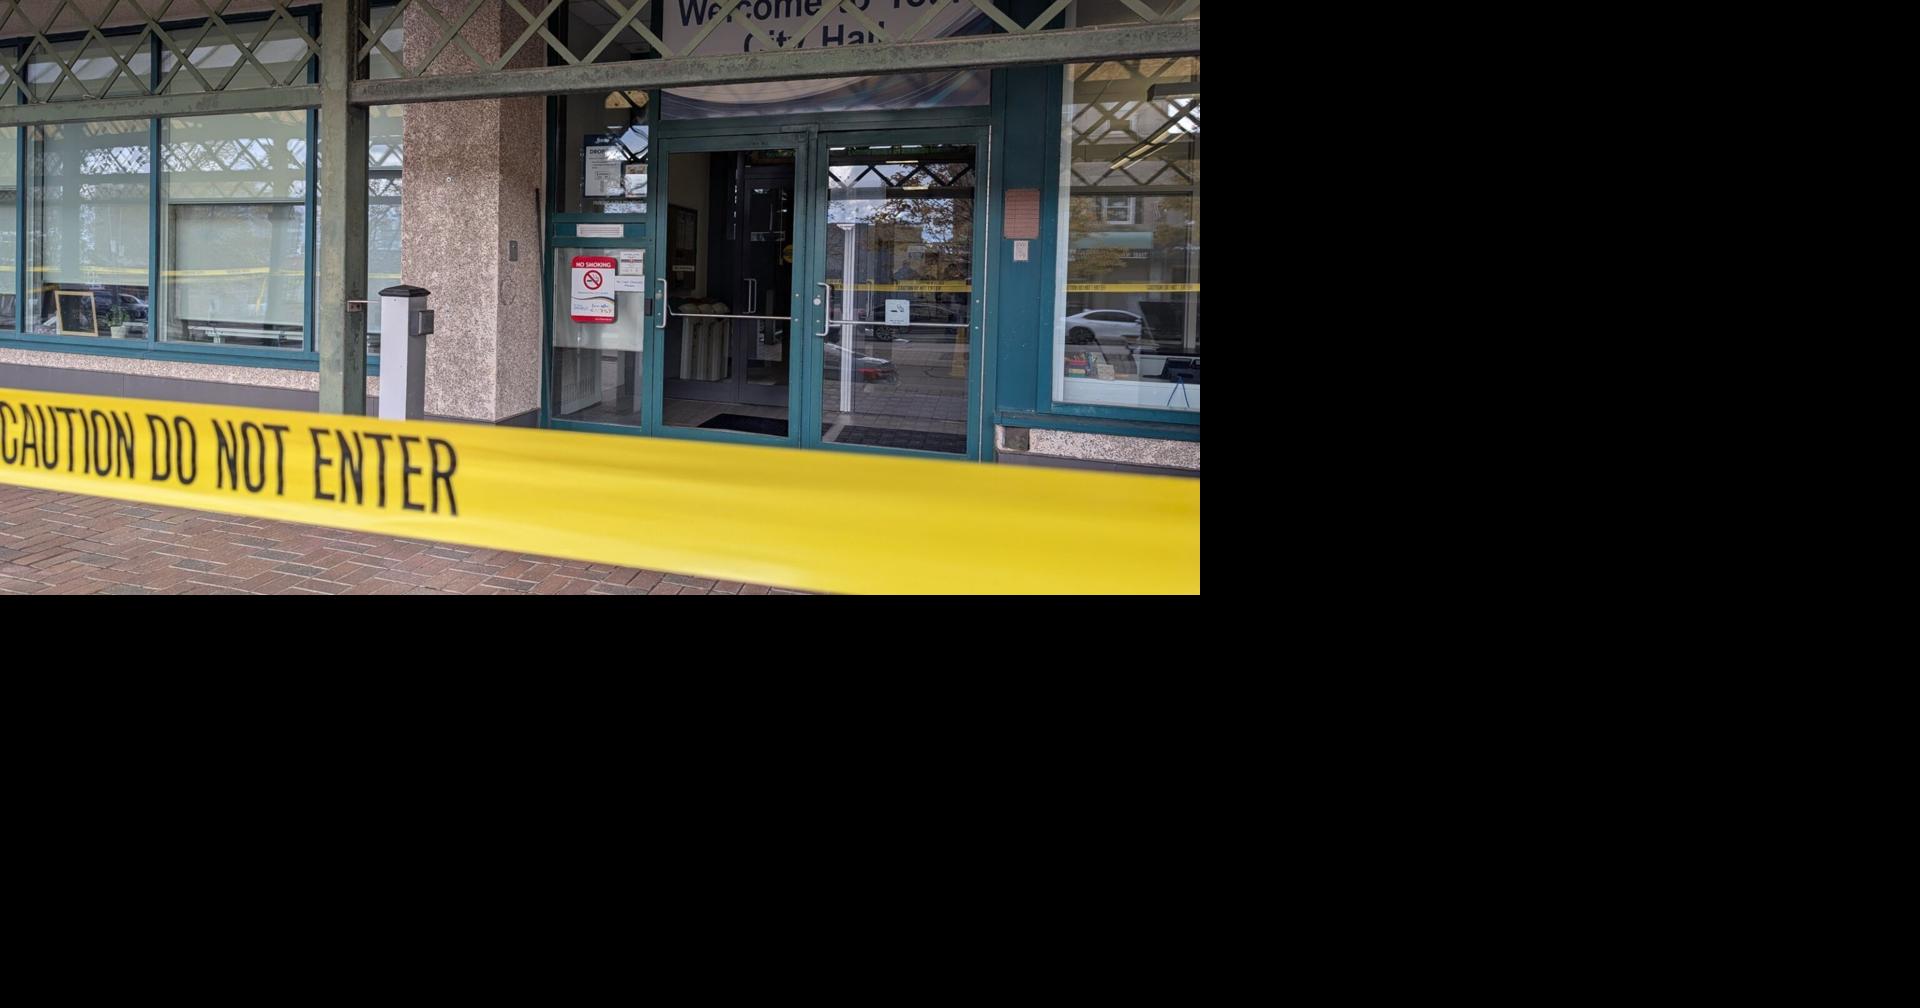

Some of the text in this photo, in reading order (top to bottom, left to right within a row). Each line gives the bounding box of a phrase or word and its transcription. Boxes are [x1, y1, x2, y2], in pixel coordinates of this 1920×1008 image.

[0, 401, 459, 517] CAUTION DO NOT ENTER
